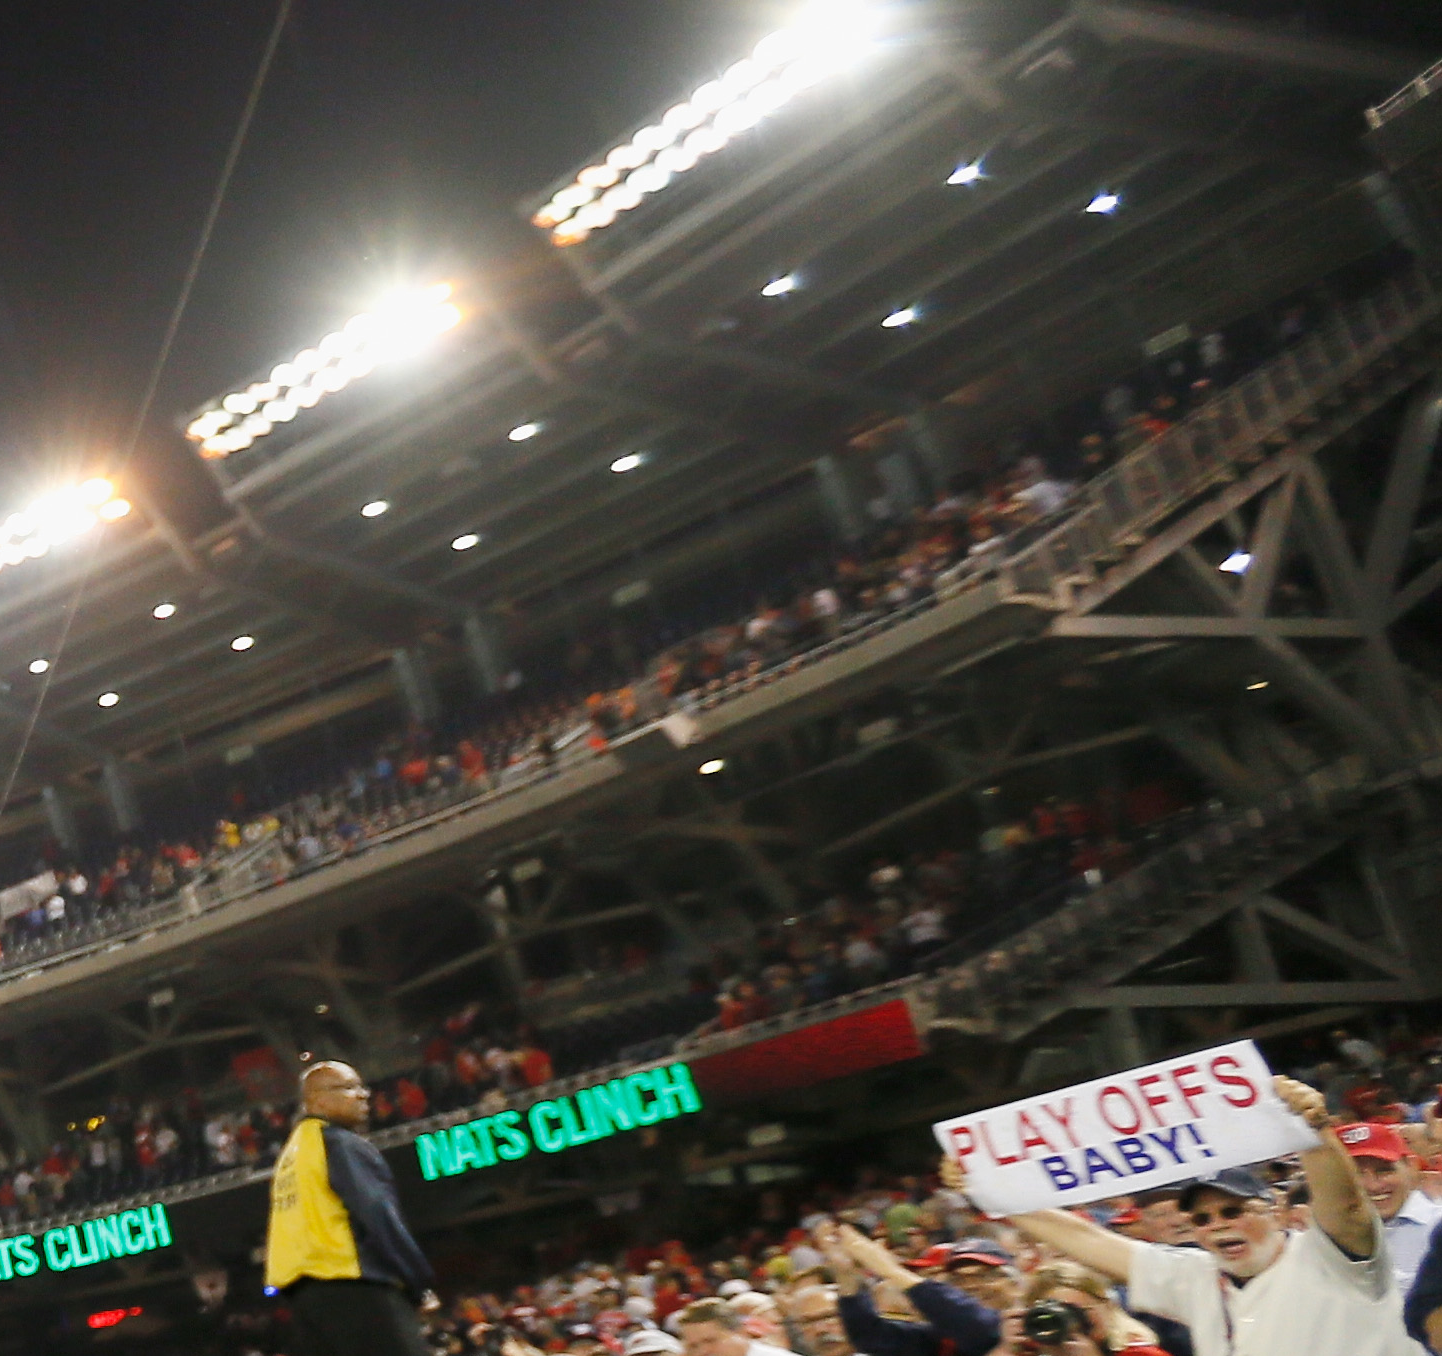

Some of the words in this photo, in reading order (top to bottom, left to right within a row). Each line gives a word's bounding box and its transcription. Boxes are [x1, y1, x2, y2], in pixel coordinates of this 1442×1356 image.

[416, 1110, 530, 1181] NATS
[530, 1061, 704, 1155] CLINCH
[945, 1095, 1078, 1176] PLAY
[1101, 1055, 1259, 1137] OFFS
[1042, 1123, 1219, 1193] BABY!
[43, 1201, 173, 1272] CLINCH
